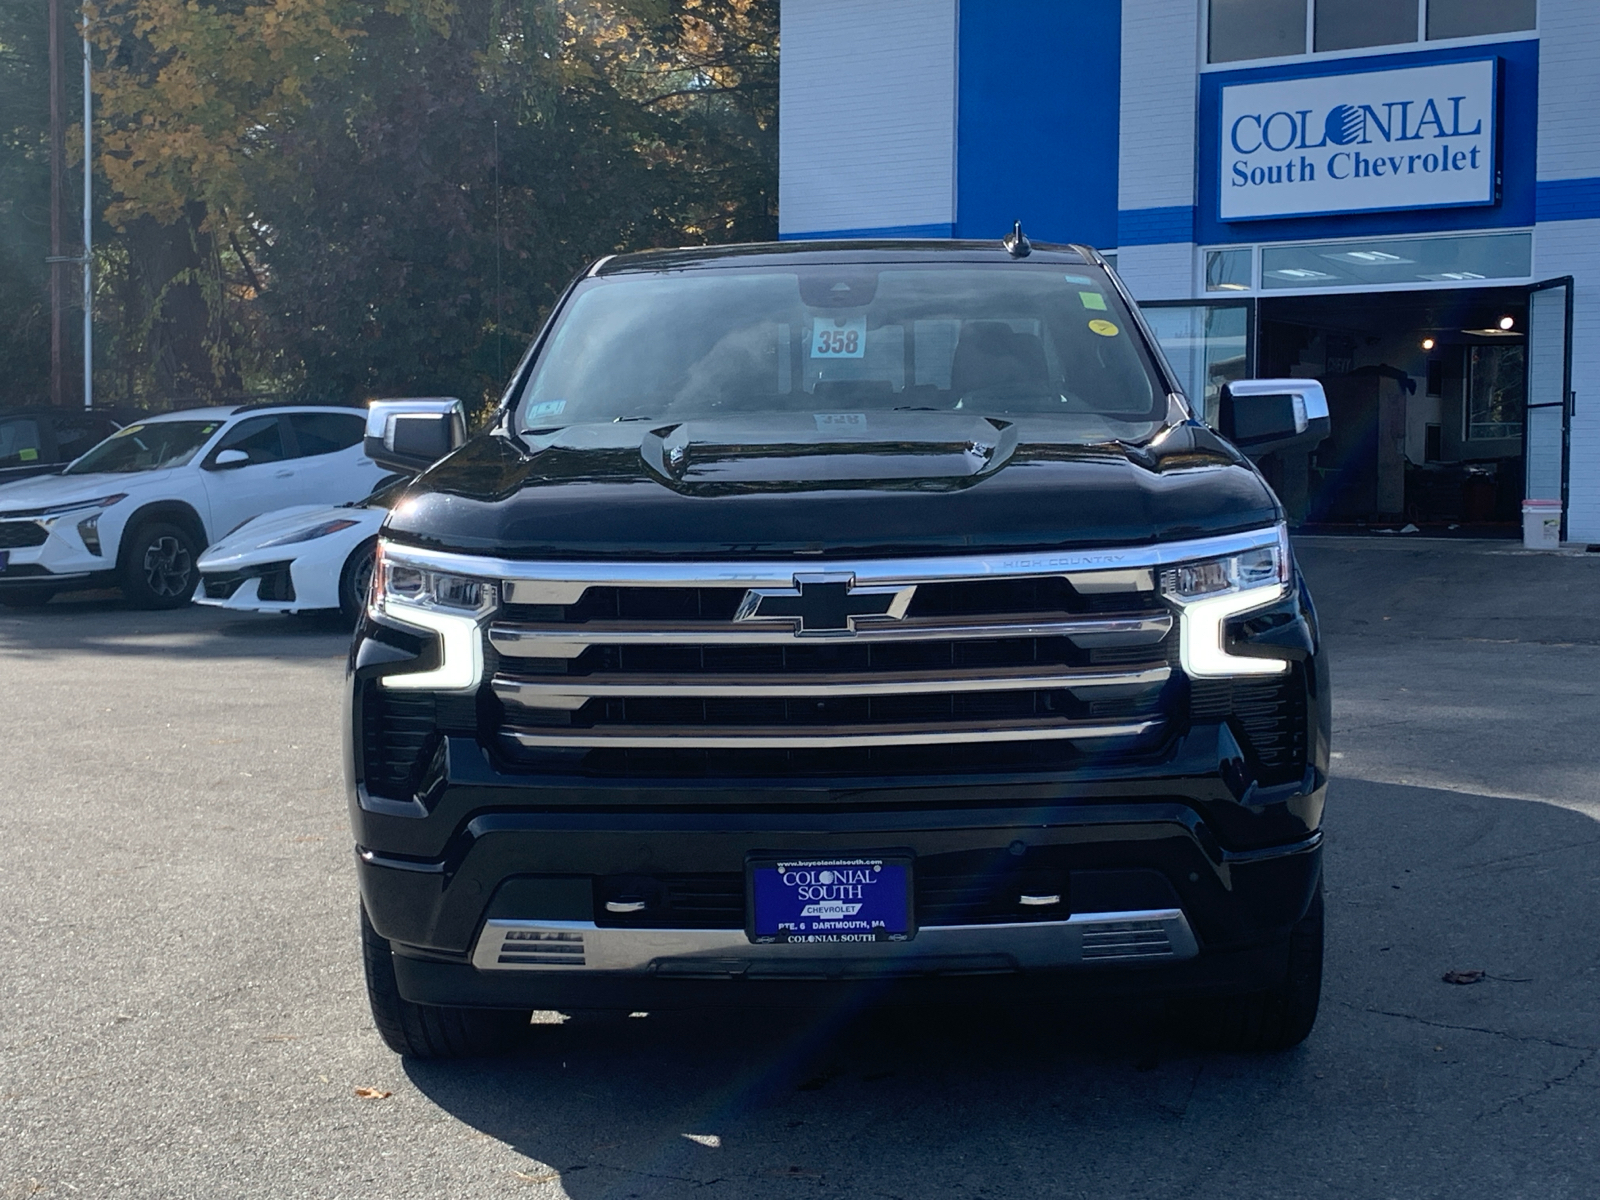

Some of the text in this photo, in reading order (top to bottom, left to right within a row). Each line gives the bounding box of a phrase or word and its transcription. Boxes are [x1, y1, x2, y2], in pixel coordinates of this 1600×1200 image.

[1231, 96, 1482, 154] COLONIAL
[1232, 145, 1481, 187] South Chevrolet
[817, 331, 859, 354] 358
[1003, 555, 1125, 568] HIGH COUNTRY
[783, 870, 877, 885] COLONIAL
[798, 885, 863, 900] SOUTH
[806, 905, 856, 914] CHEVROLET
[812, 920, 870, 930] DARTMOUTH,
[871, 920, 885, 928] MA
[787, 934, 876, 943] COLONIAL SOUTH
